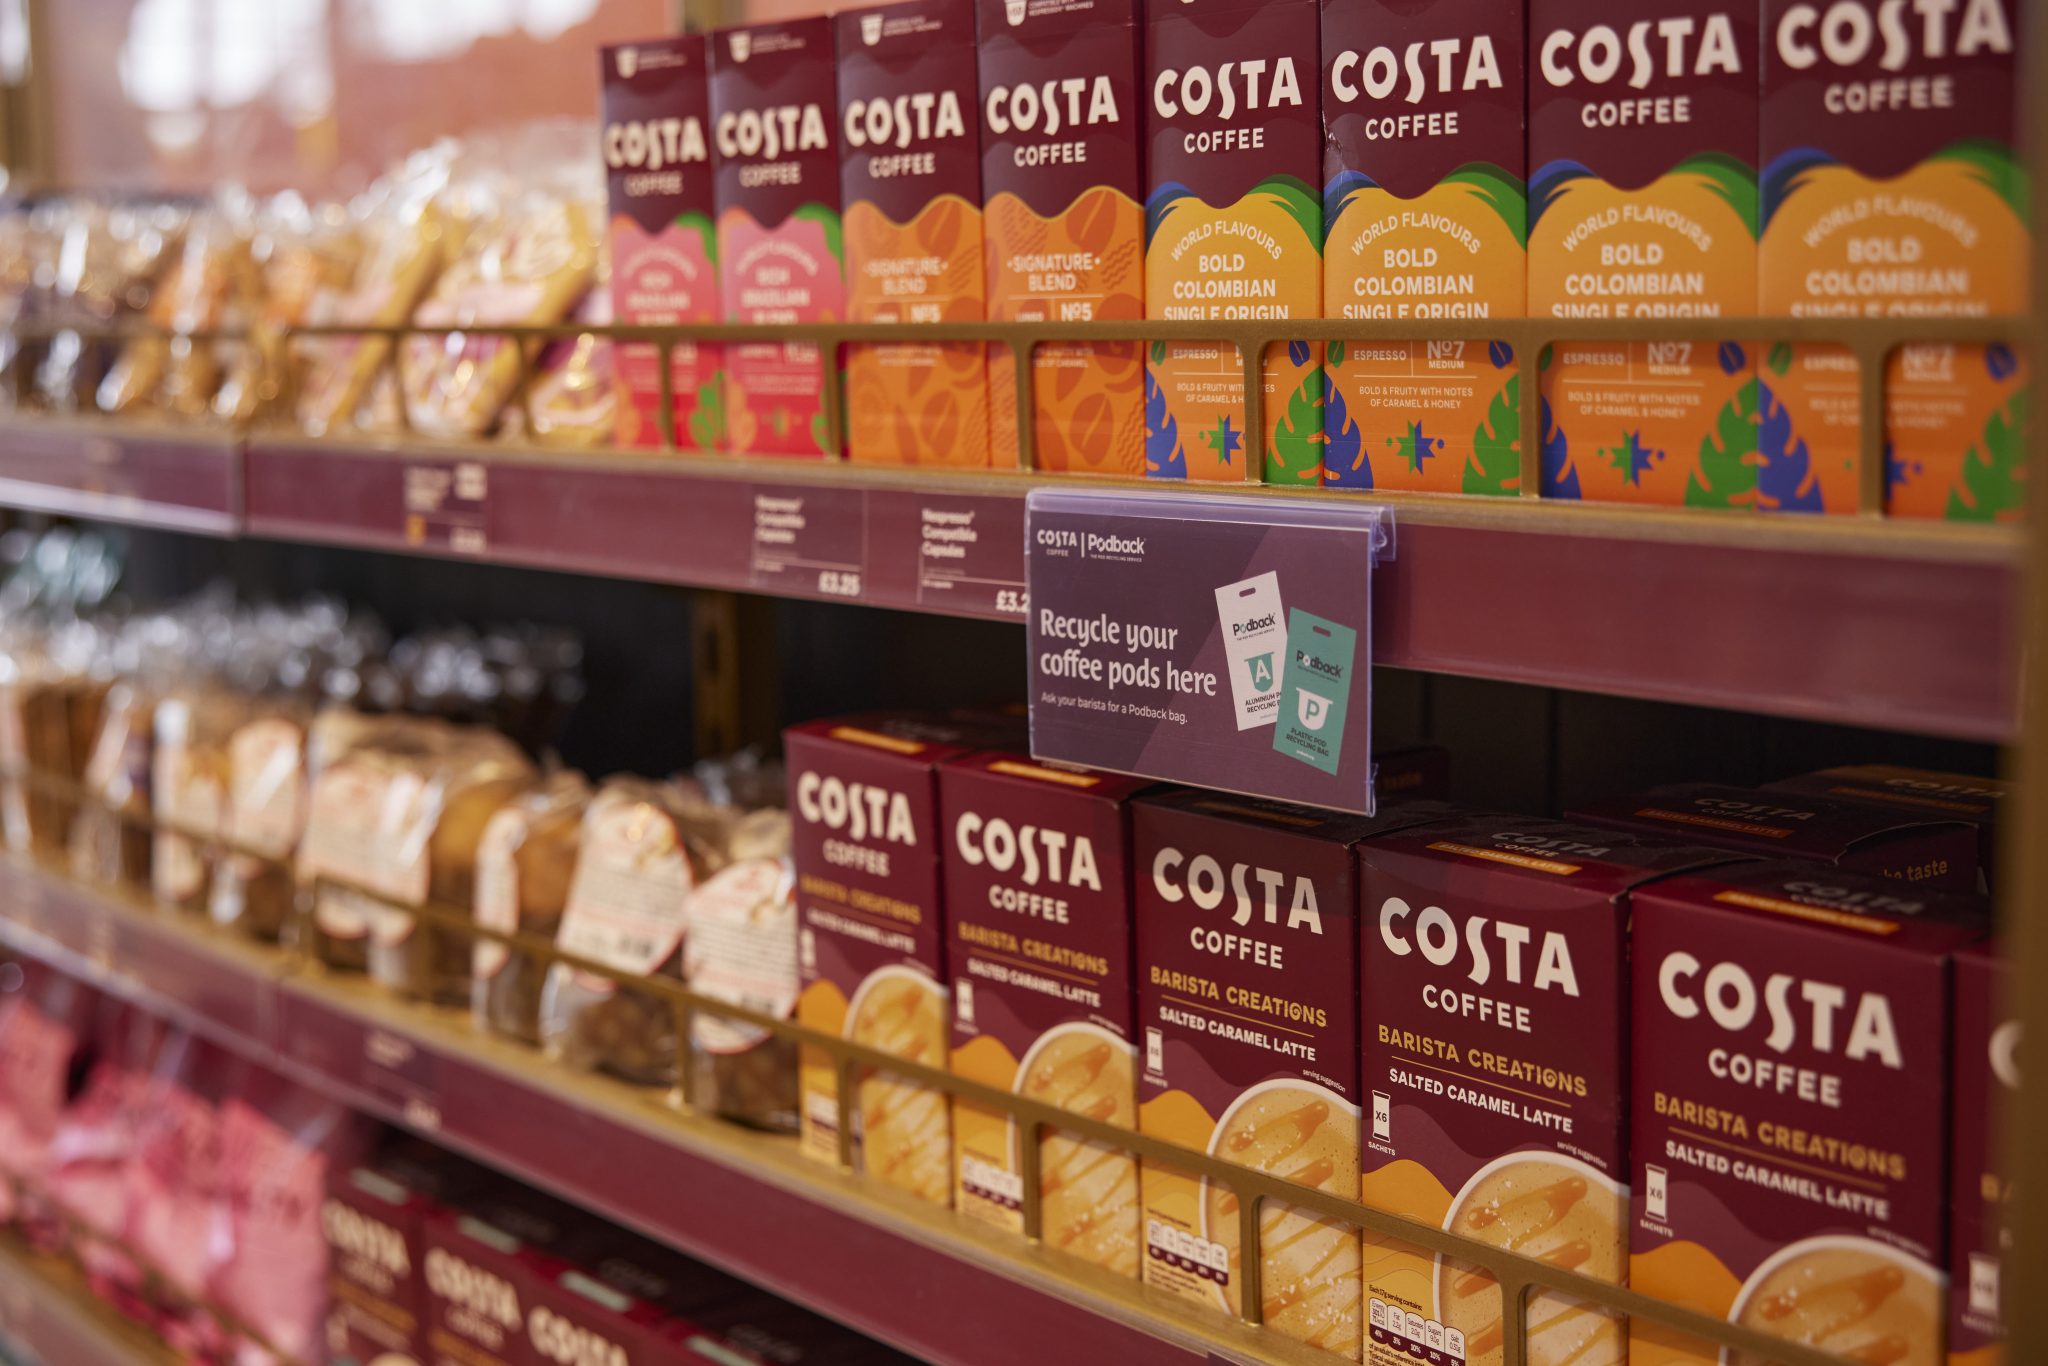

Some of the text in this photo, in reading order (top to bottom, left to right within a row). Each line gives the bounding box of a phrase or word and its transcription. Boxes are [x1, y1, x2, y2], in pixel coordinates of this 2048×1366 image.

[1777, 0, 2012, 71] COSTA
[1541, 14, 1742, 90] COSTA
[1331, 35, 1503, 104] COSTA
[1154, 57, 1302, 120] COSTA
[1824, 75, 1954, 113] COFFEE
[845, 91, 965, 148] COSTA
[986, 76, 1119, 135] COSTA
[1581, 97, 1690, 127] COFFEE
[716, 104, 828, 160] COSTA
[1184, 127, 1264, 154] COFFEE
[1365, 112, 1458, 140] COFFEE
[603, 116, 707, 170] COSTA
[1014, 142, 1086, 167] COFFEE
[868, 153, 935, 178] COFFEE
[1171, 221, 1282, 261] WORLD FLAVOURS
[1352, 212, 1481, 256] WORLD FLAVOURS
[1563, 204, 1713, 252] WORLD FLAVOURS
[1199, 254, 1244, 273] BOLD
[1384, 248, 1438, 268] BOLD
[1601, 244, 1664, 265] BOLD
[1847, 236, 1921, 262] BOLD
[1029, 273, 1075, 291] BLEND
[1173, 280, 1275, 299] COLOMBIAN
[1354, 275, 1474, 296] COLOMBIAN
[1565, 273, 1704, 295] COLOMBIAN
[1225, 305, 1288, 320] ORIGIN
[1415, 303, 1488, 319] ORIGIN
[1173, 349, 1218, 359] ESPRESSO
[1354, 350, 1407, 361] ESPRESSO
[1360, 387, 1380, 395] BOLD
[1390, 387, 1417, 396] FRUITY
[1420, 388, 1441, 396] WITH
[1444, 388, 1473, 397] NOTES
[1371, 399, 1461, 408] OF CARAMEL & HONEY
[1037, 529, 1144, 554] COSTA Podback
[1041, 608, 1178, 653] Recycle your
[1233, 614, 1275, 636] Podback
[1041, 649, 1216, 696] coffee pods here
[1256, 660, 1271, 684] A
[1042, 692, 1056, 703] Ask
[1057, 695, 1076, 707] your
[1078, 696, 1106, 711] barista
[1108, 701, 1119, 713] for
[1129, 704, 1166, 720] Podback
[1169, 710, 1188, 724] bag.
[1245, 692, 1274, 706] ALUMINIUM
[1247, 701, 1275, 714] RECYCLING
[1306, 699, 1319, 720] P
[1286, 734, 1316, 752] RECYCLING
[1317, 746, 1329, 757] BAG
[1291, 728, 1326, 747] PLASTIC POD
[798, 771, 916, 846] COSTA
[956, 811, 1102, 891] COSTA
[1907, 860, 1947, 881] taste
[988, 885, 1069, 924] COFFEE
[1153, 847, 1322, 934] COSTA
[959, 921, 1109, 976] BARISTA CREATIONS
[1190, 926, 1283, 969] COFFEE
[1379, 896, 1580, 997] COSTA
[967, 958, 1101, 1007] SALTED CARAMEL LATTE
[1151, 966, 1327, 1028] BARISTA CREATIONS
[1422, 984, 1532, 1033] COFFEE
[1659, 952, 1903, 1070] COSTA
[1159, 1006, 1316, 1062] SALTED CARAMEL LATTE
[1379, 1024, 1588, 1097] BARISTA CREATIONS
[1303, 1069, 1345, 1093] serving suggestion
[1708, 1048, 1841, 1108] COFFEE
[1390, 1068, 1572, 1133] SALTED CARAMEL LATTE
[1376, 1109, 1387, 1123] X6
[1368, 1141, 1396, 1156] SACHETS
[1654, 1091, 1905, 1180] BARISTA CREATIONS
[1650, 1187, 1662, 1199] X6
[1666, 1140, 1890, 1221] SALTED CARAMEL LATTE
[1640, 1220, 1674, 1237] SACHETS
[1388, 1294, 1402, 1304] serving
